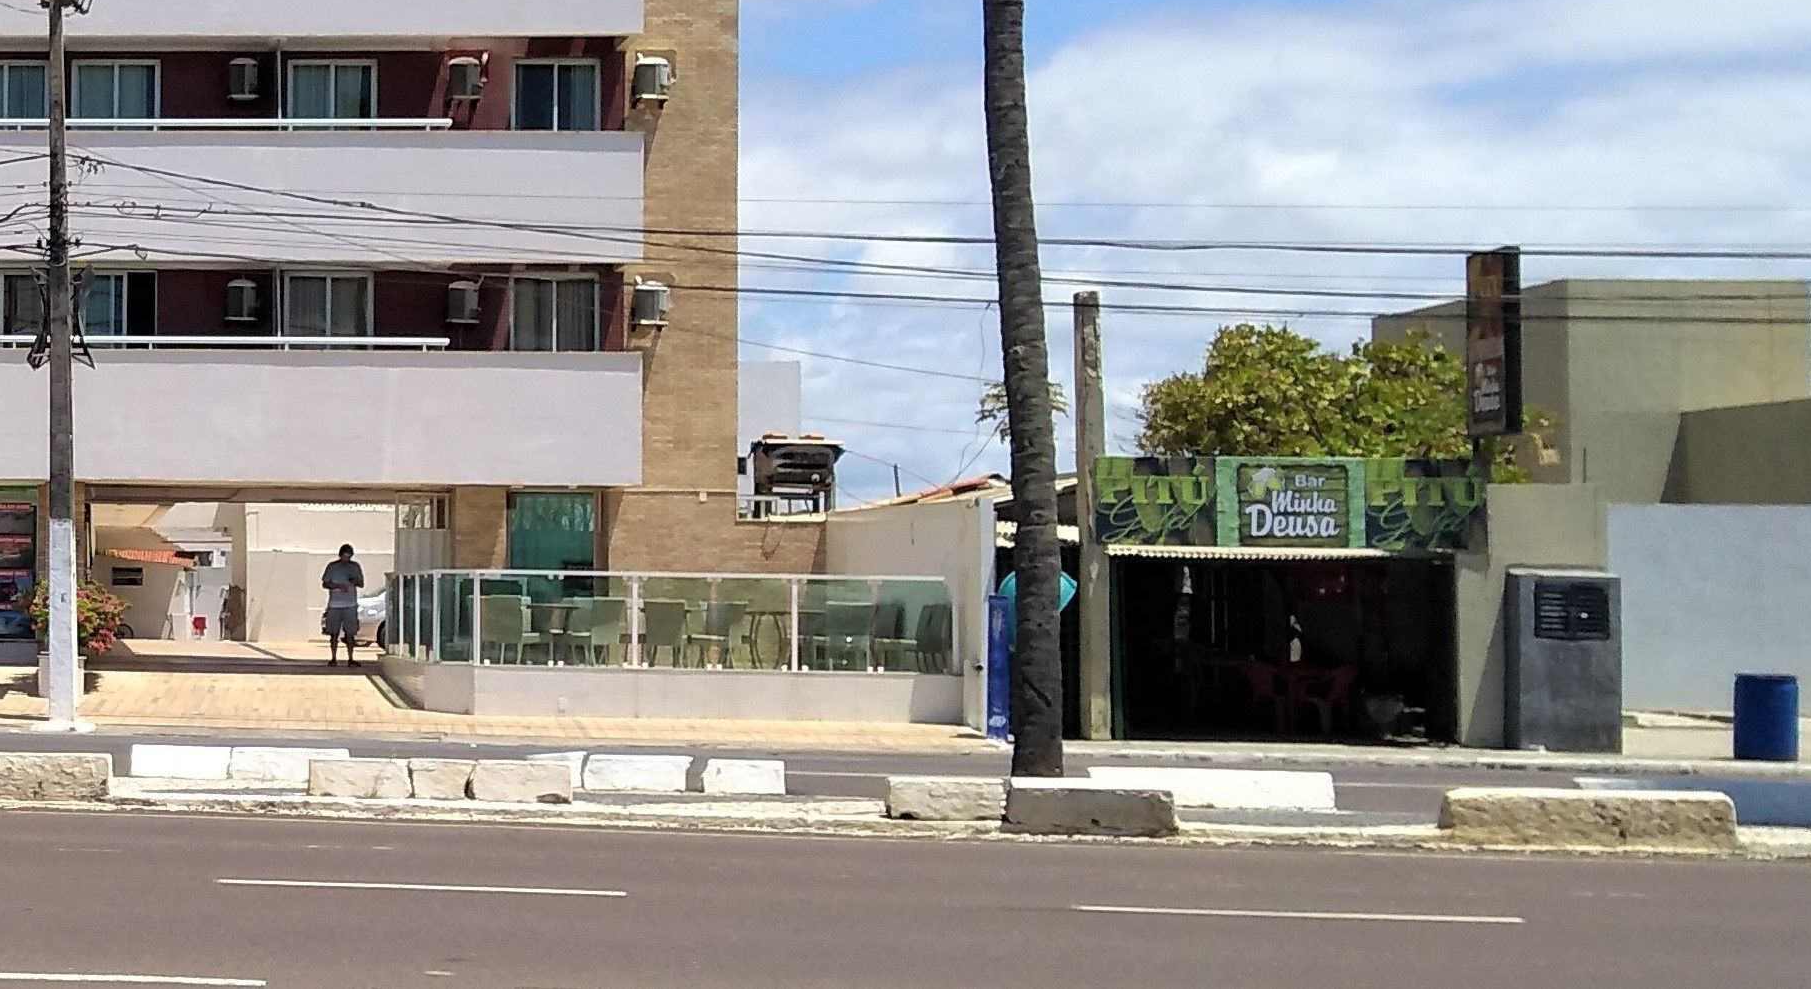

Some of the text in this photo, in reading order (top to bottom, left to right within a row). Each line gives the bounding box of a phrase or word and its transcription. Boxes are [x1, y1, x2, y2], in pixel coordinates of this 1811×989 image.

[1295, 474, 1326, 488] Bar
[1271, 490, 1338, 513] Minha
[1245, 503, 1340, 537] Deusa
